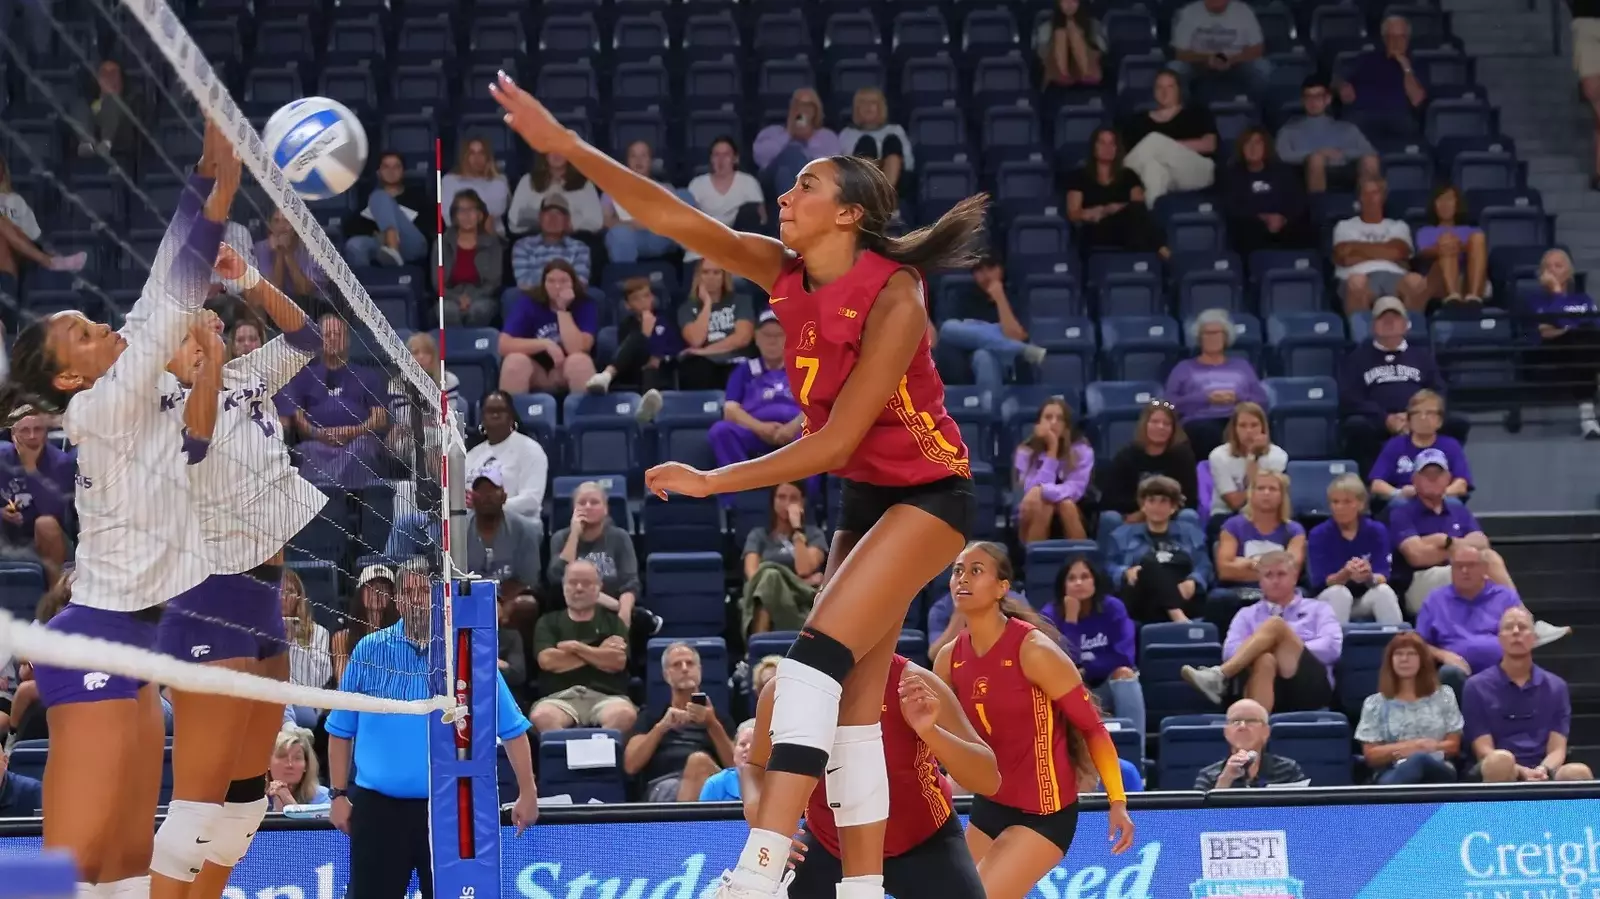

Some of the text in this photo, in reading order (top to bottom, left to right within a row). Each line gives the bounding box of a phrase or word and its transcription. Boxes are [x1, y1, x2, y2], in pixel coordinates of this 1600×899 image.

[795, 356, 820, 407] 7
[975, 703, 992, 736] 1
[1209, 836, 1280, 860] BEST
[515, 841, 1161, 899] Stud sed
